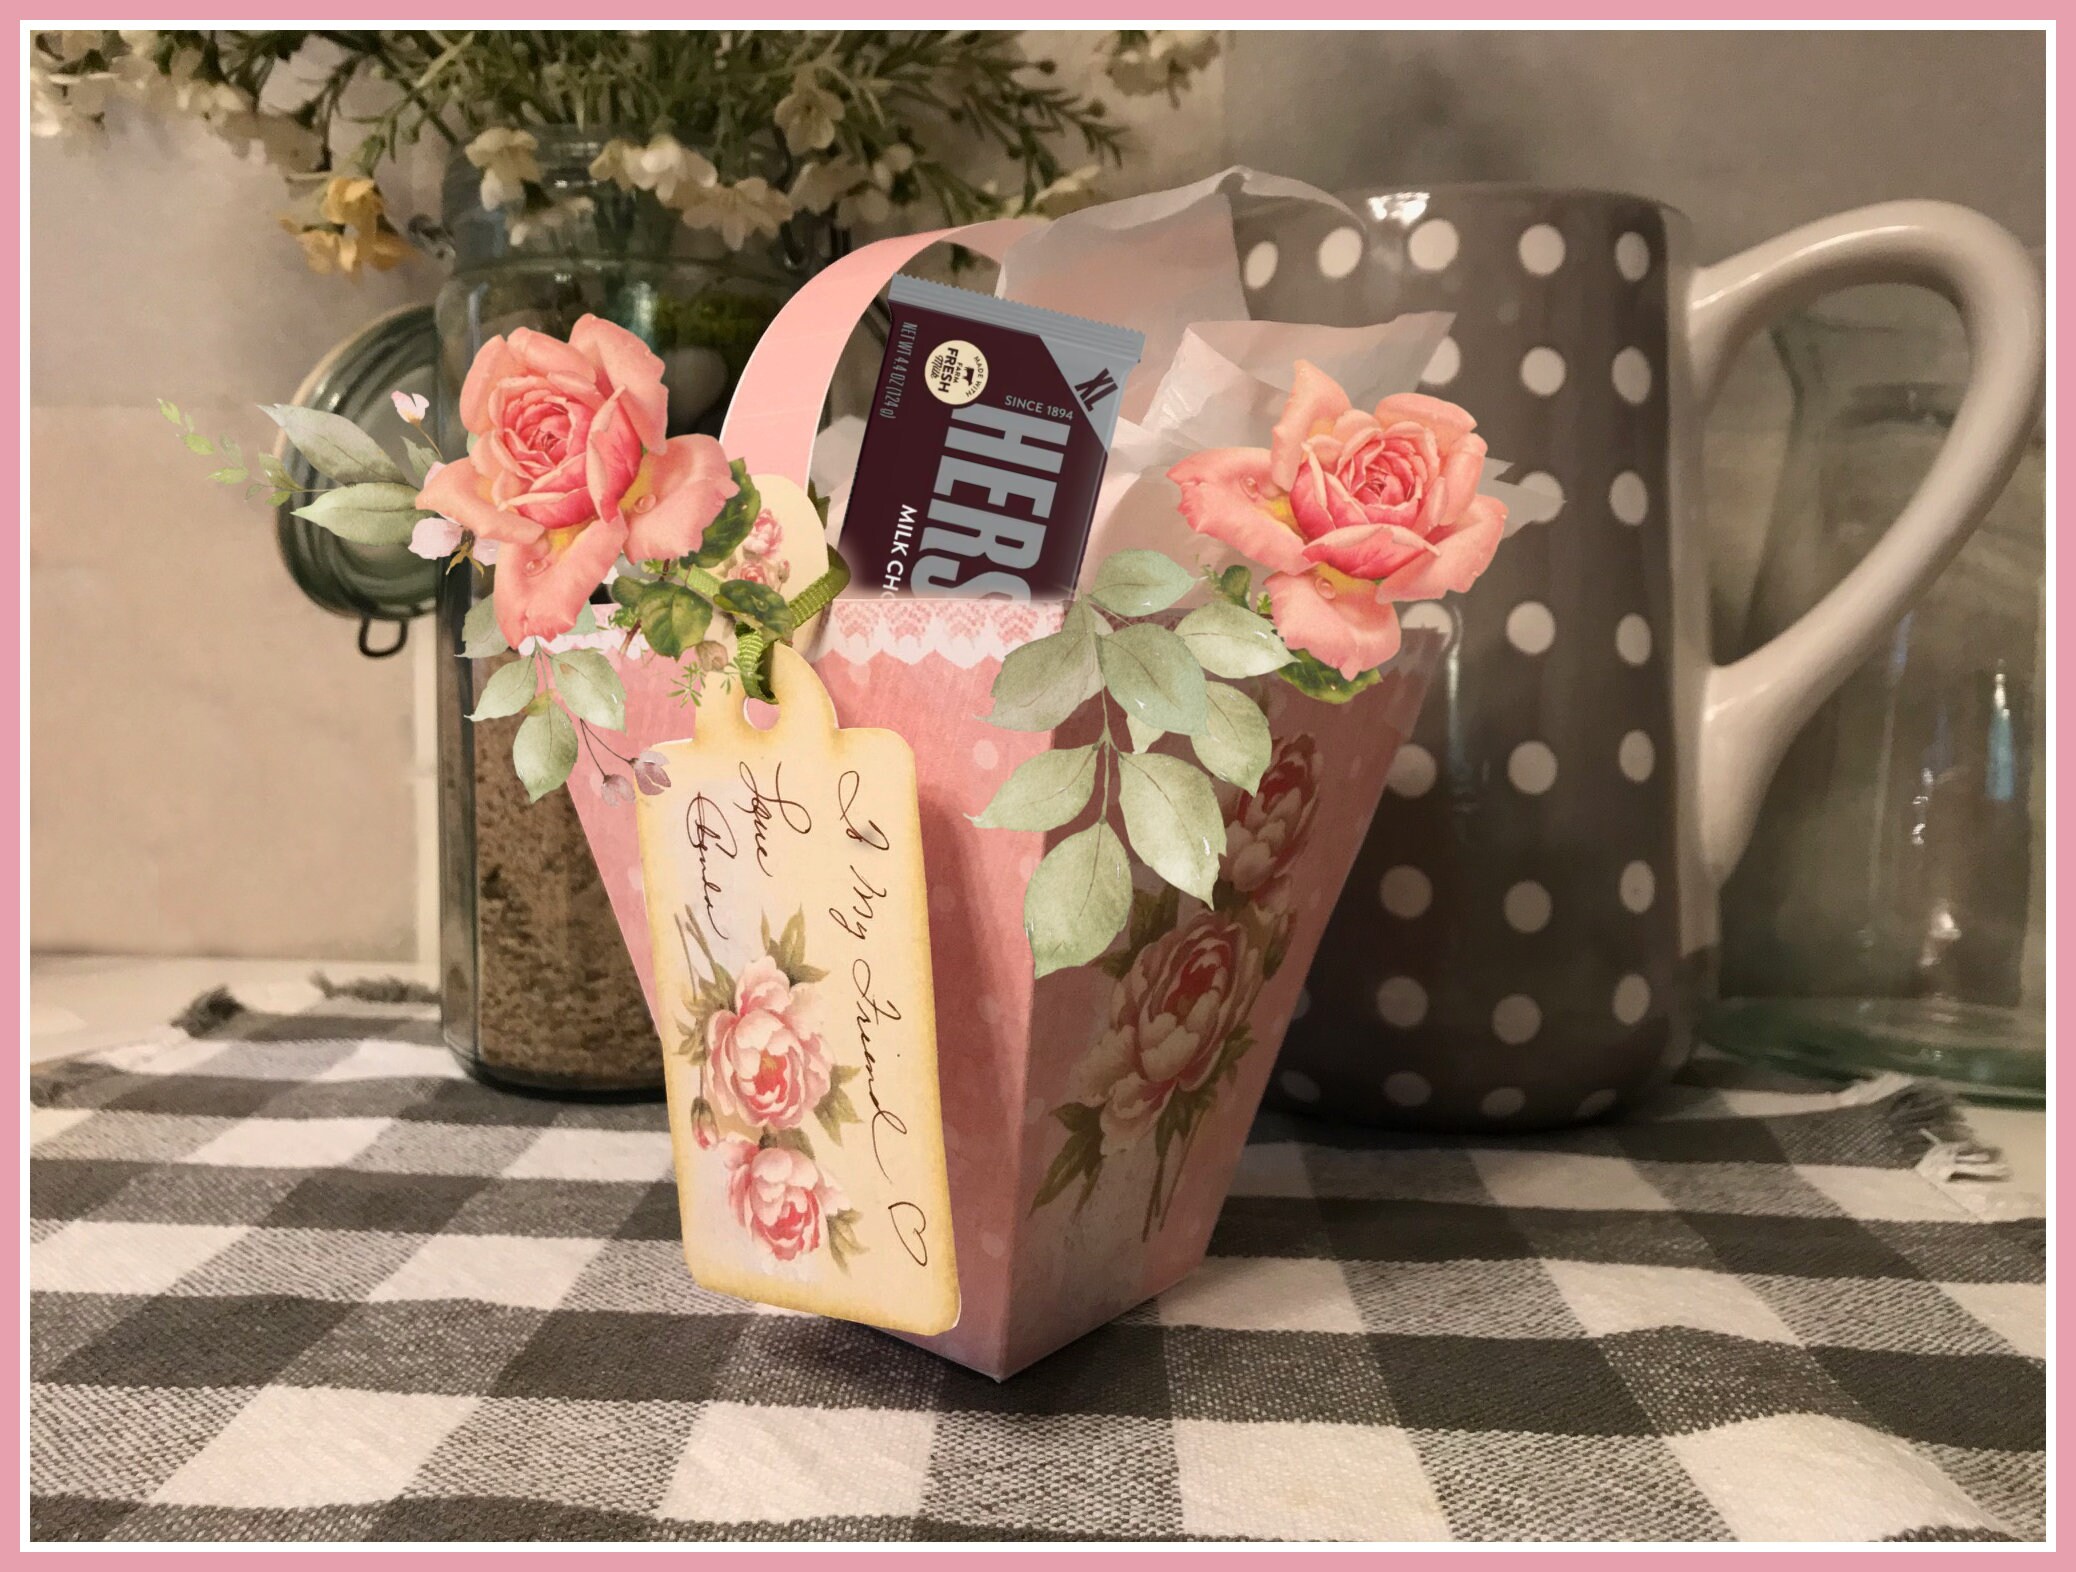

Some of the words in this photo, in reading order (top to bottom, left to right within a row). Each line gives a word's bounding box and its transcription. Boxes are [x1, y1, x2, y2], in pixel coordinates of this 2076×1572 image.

[900, 321, 918, 341] NET
[897, 341, 914, 356] WT
[893, 357, 909, 372] 4.4
[937, 347, 959, 393] FRESH
[953, 362, 963, 384] FARM
[974, 356, 984, 379] MADE
[889, 372, 906, 387] OZ
[965, 381, 982, 398] WITH
[1074, 367, 1118, 412] XL
[884, 386, 902, 408] (124
[1004, 395, 1044, 413] SINCE
[1047, 405, 1074, 421] 1894
[891, 504, 918, 557] MILK
[733, 761, 812, 877] Love
[838, 770, 889, 850] To
[829, 865, 887, 940] My
[852, 958, 907, 1184] Friend
